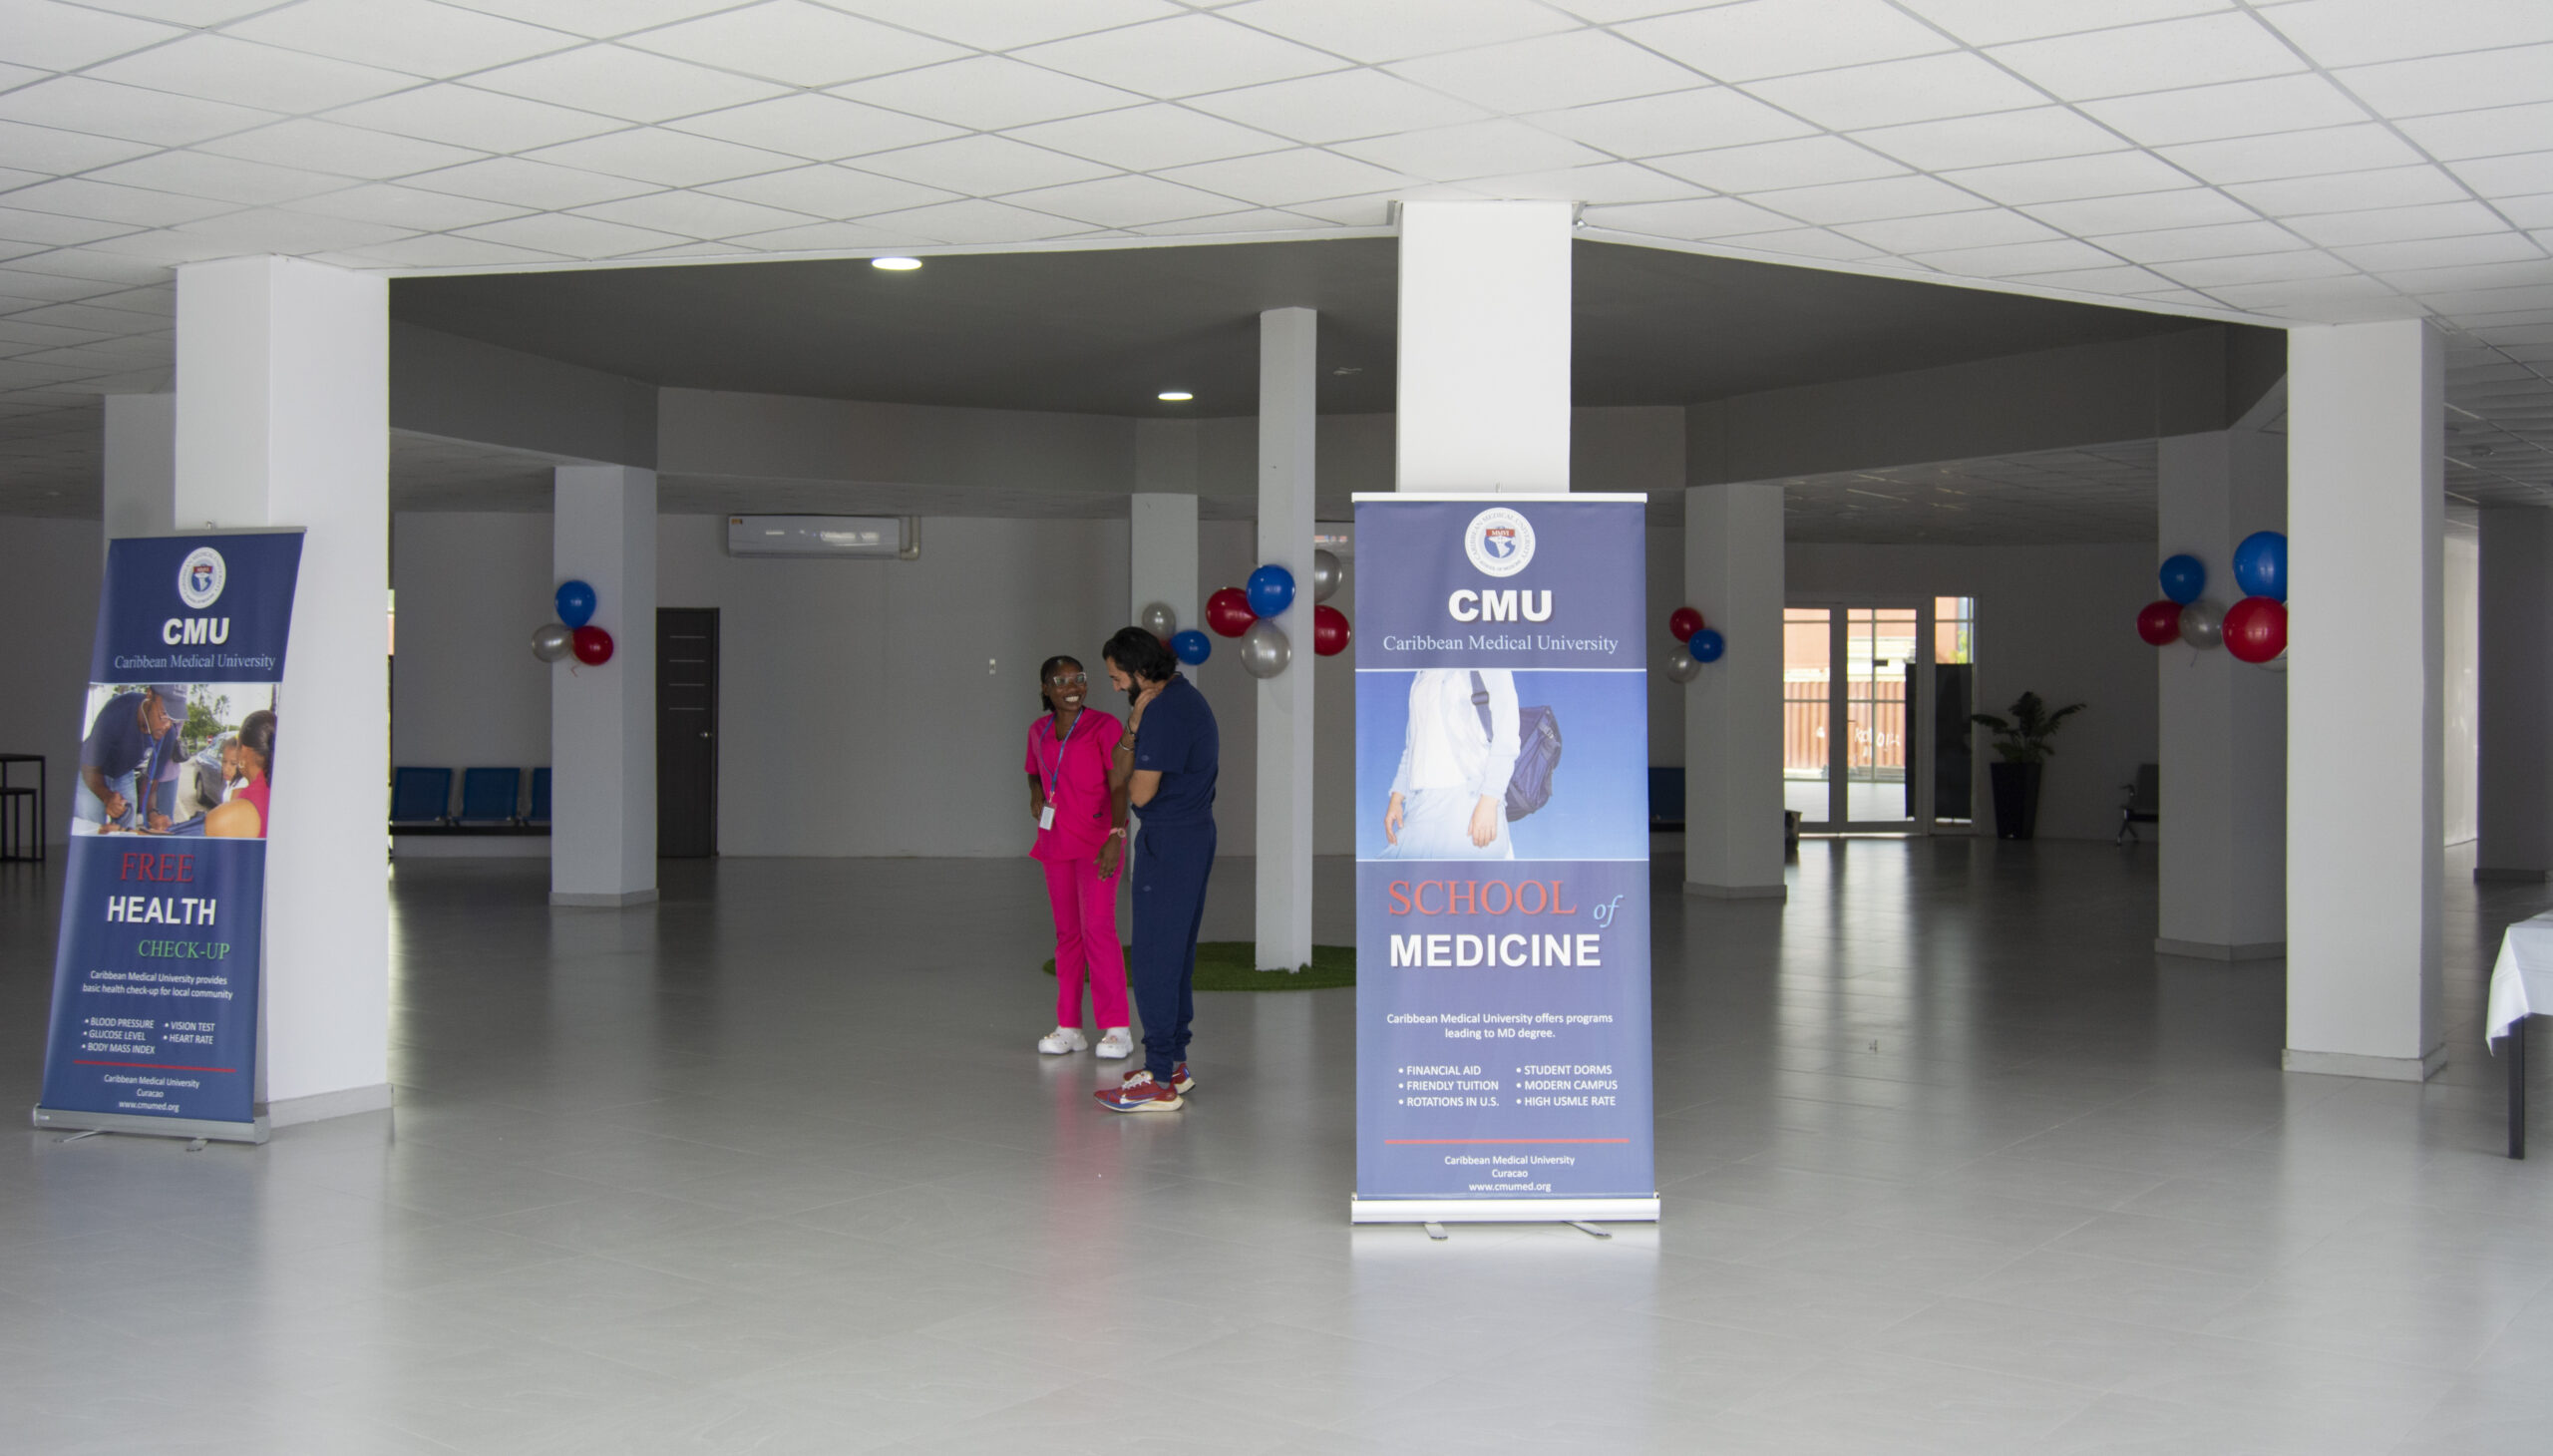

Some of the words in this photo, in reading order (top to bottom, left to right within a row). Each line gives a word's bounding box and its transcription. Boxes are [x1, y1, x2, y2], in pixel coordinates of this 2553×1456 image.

[1469, 521, 1483, 560] CARIBBEAN
[1482, 512, 1514, 521] MEDICAL
[1515, 518, 1531, 559] UNIVERSITY
[1448, 589, 1553, 622] CMU
[163, 617, 230, 645] CMU
[1383, 635, 1463, 651] Caribbean
[1469, 634, 1532, 650] Medical
[1538, 634, 1619, 654] University
[115, 655, 168, 669] Caribbean
[171, 654, 215, 668] Medical
[217, 653, 276, 670] University
[120, 853, 195, 883] FREE
[1388, 880, 1577, 915] SCHOOL
[1594, 895, 1624, 928] of
[107, 896, 216, 925] HEALTH
[138, 939, 231, 960] CHECK-UP
[1390, 933, 1602, 967] MEDICINE
[90, 970, 127, 980] Caribbean
[128, 971, 157, 982] Medical
[159, 973, 194, 984] University
[195, 975, 227, 985] provides
[83, 983, 101, 993] basic
[102, 983, 126, 994] health
[126, 986, 159, 995] check-up
[160, 987, 172, 996] for
[173, 987, 190, 997] local
[190, 990, 233, 1000] community
[91, 1017, 116, 1027] BLOOD
[118, 1018, 155, 1029] PRESSURE
[1386, 1013, 1438, 1023] Caribbean
[1440, 1013, 1480, 1023] Medical
[1483, 1013, 1533, 1026] University
[1535, 1013, 1565, 1023] offers
[1566, 1014, 1613, 1025] programs
[171, 1021, 196, 1031] VISION
[197, 1022, 215, 1032] TEST
[89, 1030, 123, 1040] GLUCOSE
[124, 1031, 146, 1041] LEVEL
[170, 1034, 194, 1044] HEART
[195, 1035, 213, 1044] RATE
[1445, 1028, 1482, 1040] leading
[1484, 1029, 1495, 1038] to
[1497, 1029, 1516, 1038] MD
[1518, 1028, 1556, 1040] degree.
[87, 1042, 109, 1052] BODY
[110, 1043, 131, 1053] MASS
[133, 1045, 156, 1054] INDEX
[1406, 1065, 1461, 1075] FINANCIAL
[1463, 1065, 1481, 1075] AID
[1524, 1065, 1573, 1075] STUDENT
[1574, 1065, 1613, 1075] DORMS
[104, 1074, 138, 1085] Caribbean
[139, 1076, 165, 1086] Medical
[167, 1078, 199, 1089] University
[1406, 1081, 1454, 1091] FRIENDLY
[1456, 1080, 1499, 1091] TUITION
[1525, 1080, 1572, 1091] MODERN
[1574, 1080, 1619, 1091] CAMPUS
[137, 1088, 164, 1098] Curacao
[119, 1100, 180, 1113] www.cmumed.org
[1407, 1097, 1464, 1107] ROTATIONS
[1466, 1097, 1478, 1107] IN
[1480, 1097, 1500, 1107] U.S.
[1524, 1096, 1551, 1106] HIGH
[1553, 1096, 1589, 1106] USMLE
[1592, 1096, 1616, 1106] RATE
[1444, 1155, 1490, 1166] Caribbean
[1492, 1155, 1528, 1166] Medical
[1530, 1155, 1576, 1167] University
[1491, 1169, 1529, 1178] Curacao
[1469, 1181, 1552, 1193] www.cmumed.org
